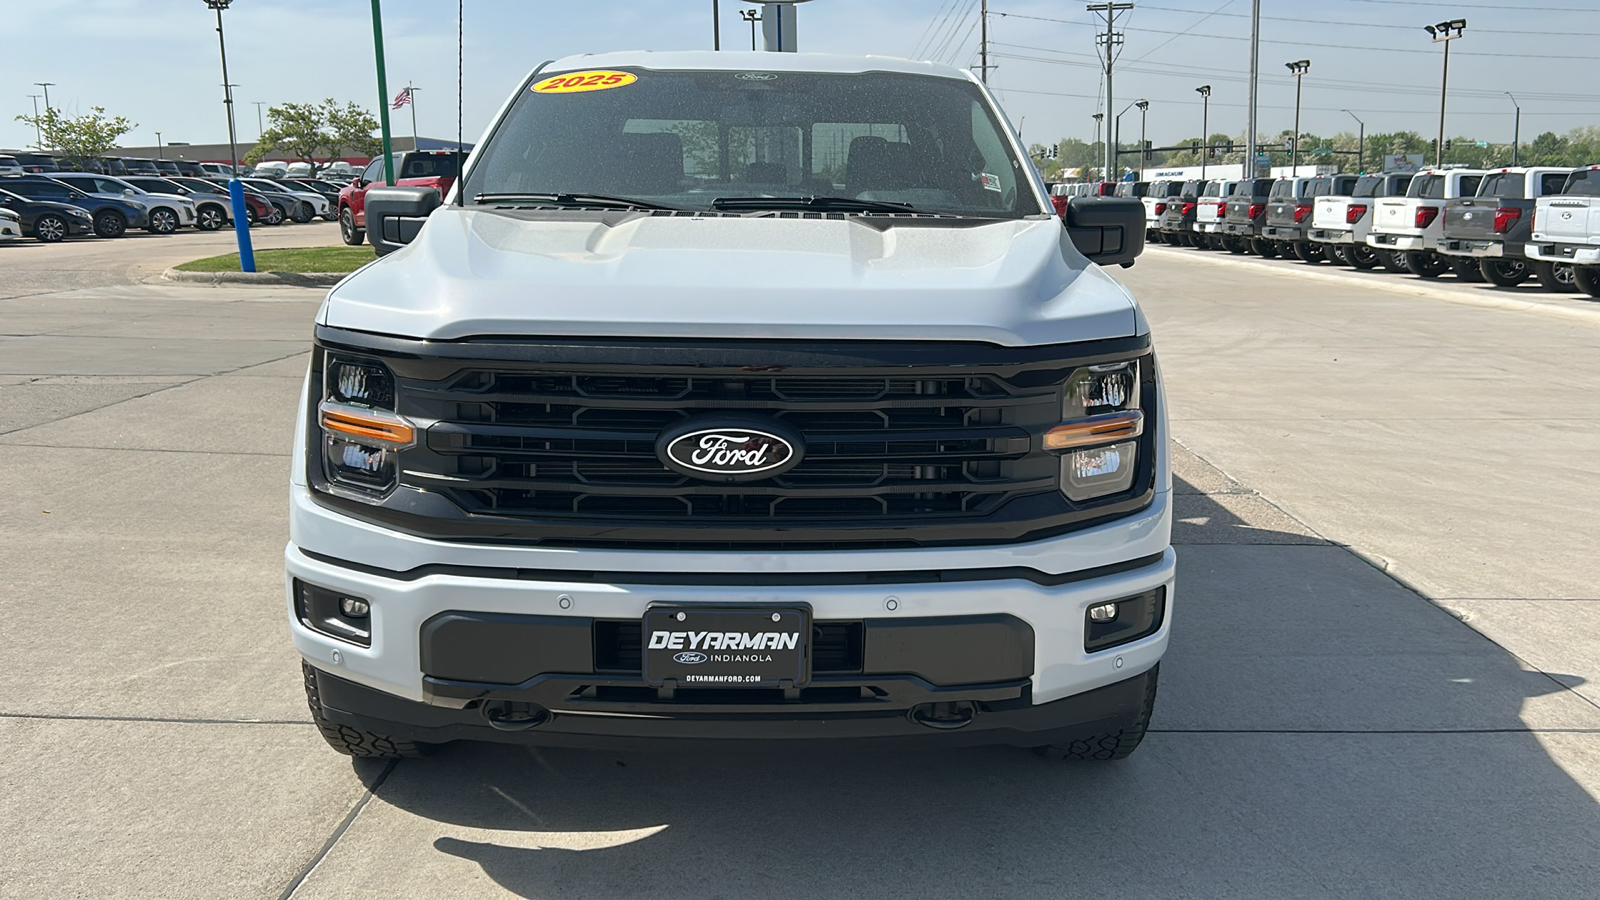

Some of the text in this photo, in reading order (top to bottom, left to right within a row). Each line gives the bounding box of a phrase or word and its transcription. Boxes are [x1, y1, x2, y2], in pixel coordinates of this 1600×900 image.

[540, 74, 627, 91] 2025
[691, 434, 769, 466] Ford
[648, 630, 799, 650] DEYARMAN
[679, 653, 772, 662] Ford INDIANOLA
